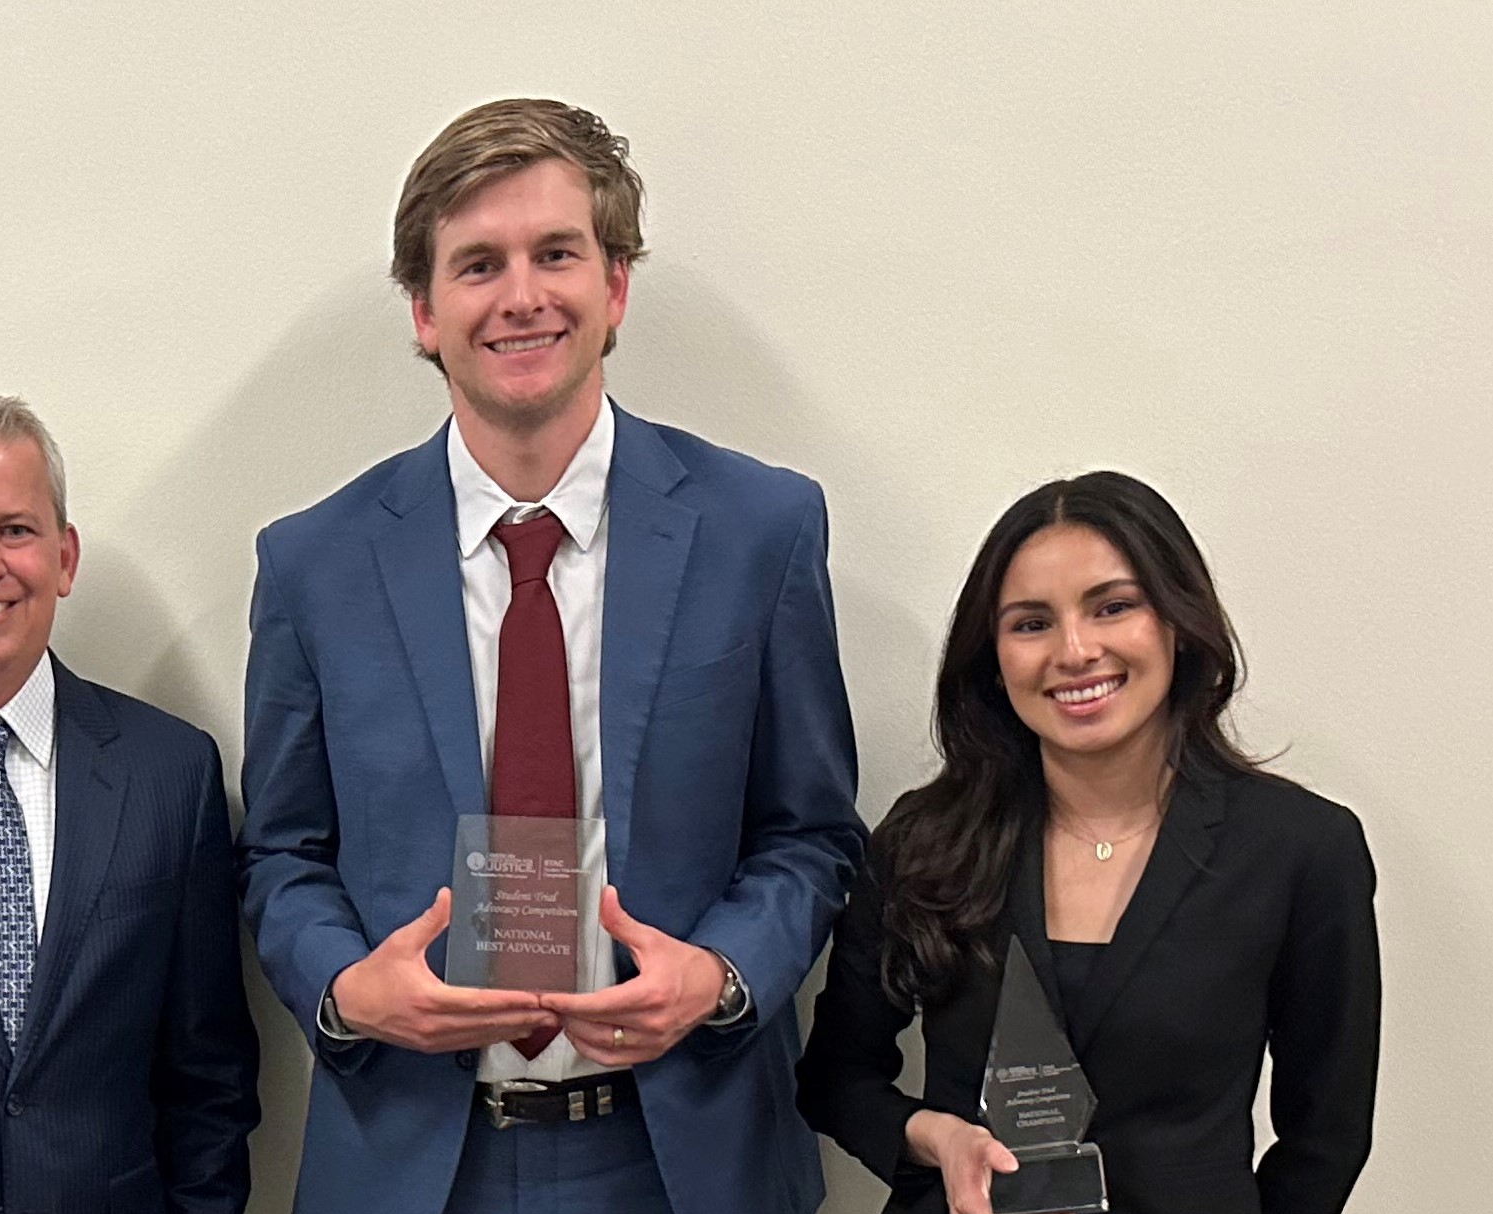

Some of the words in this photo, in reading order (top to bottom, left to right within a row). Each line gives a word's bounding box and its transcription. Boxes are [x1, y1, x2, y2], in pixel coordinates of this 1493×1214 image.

[494, 928, 554, 941] NATIONAL
[476, 941, 505, 952] BEST
[507, 942, 571, 955] ADVOCATE
